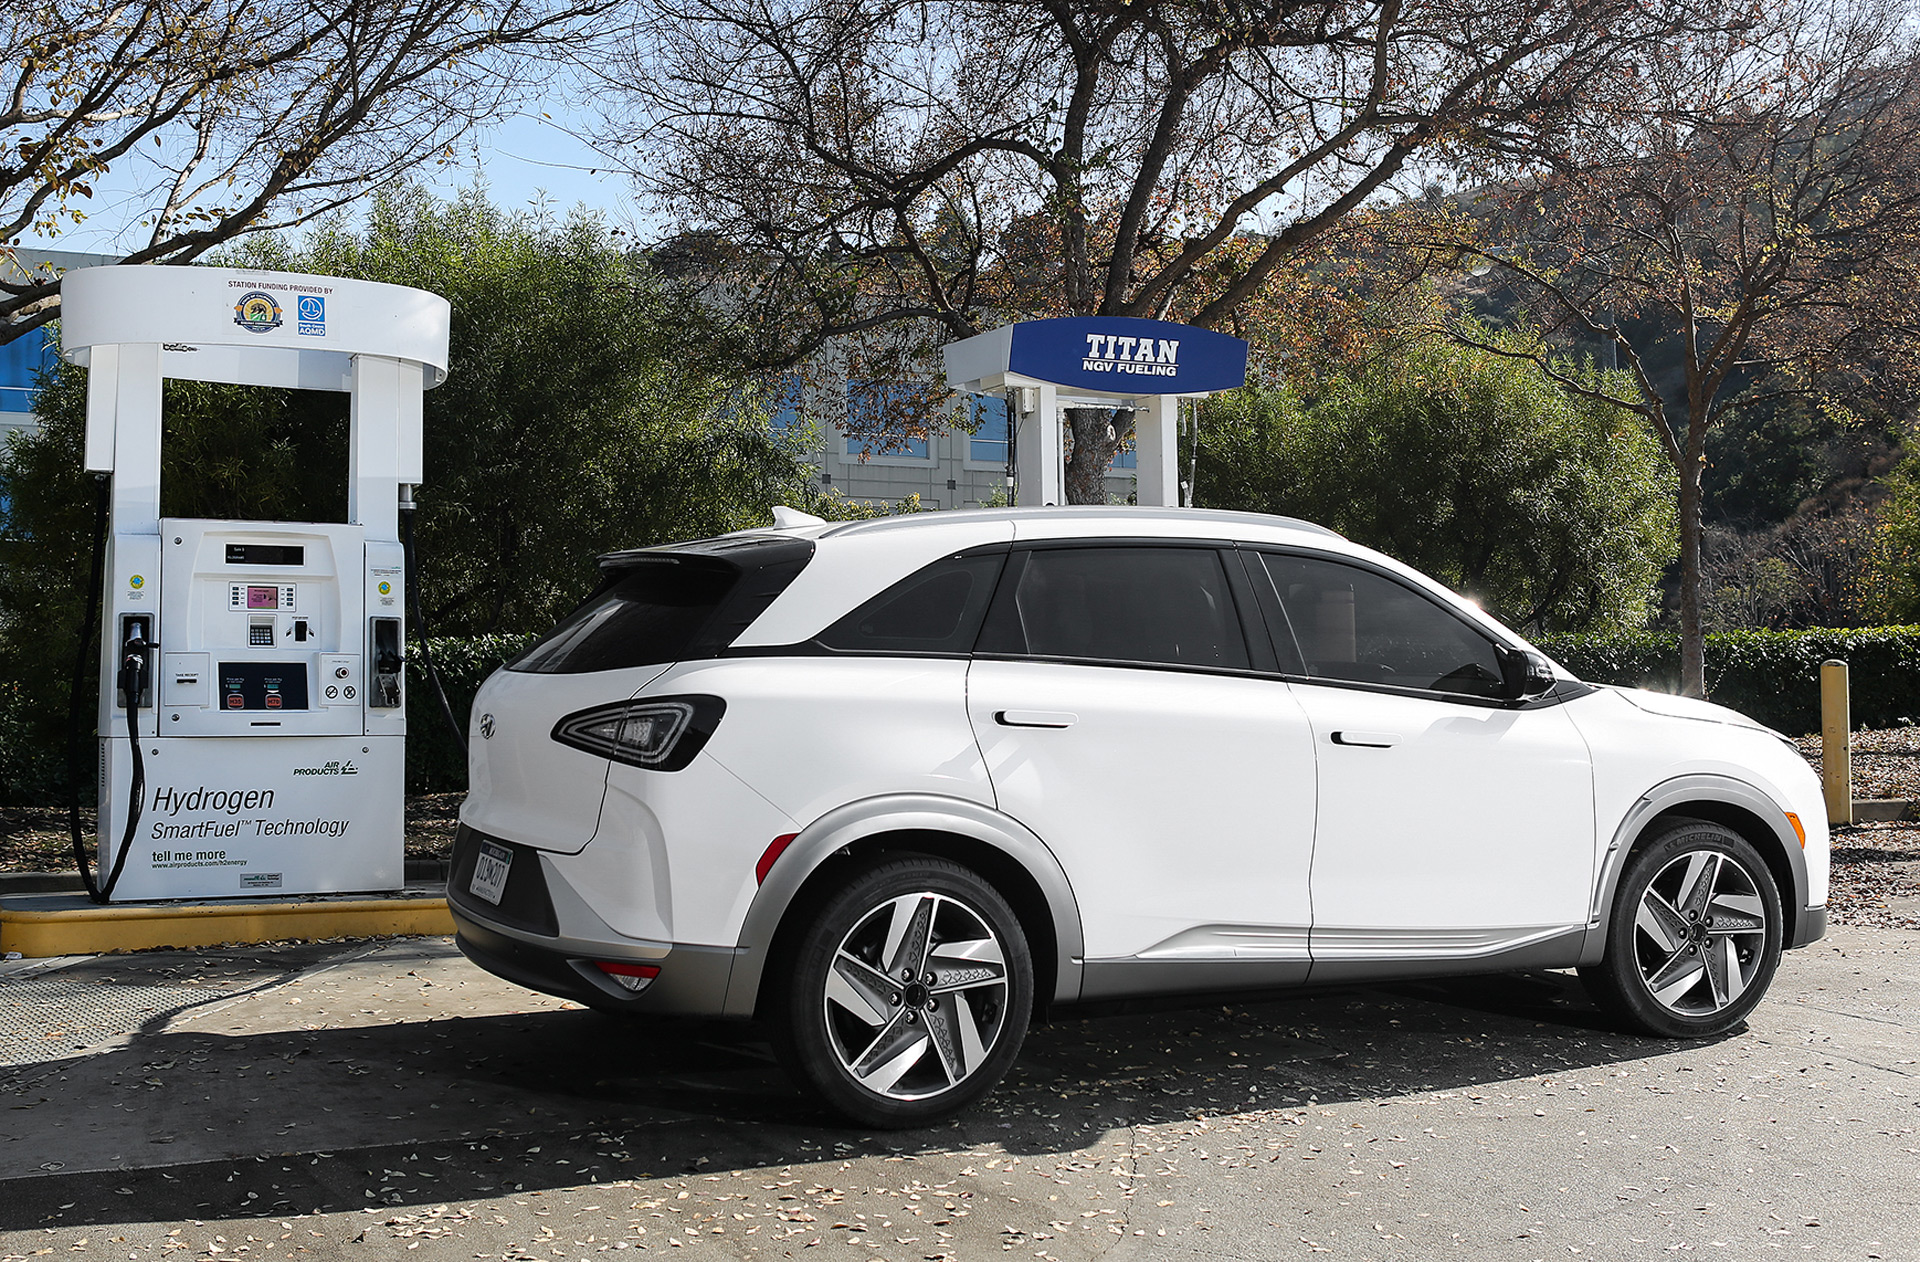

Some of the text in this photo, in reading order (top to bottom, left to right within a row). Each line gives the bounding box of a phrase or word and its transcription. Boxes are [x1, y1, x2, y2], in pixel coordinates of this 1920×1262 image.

[258, 282, 288, 291] FUNDING
[290, 285, 322, 294] PROVIDED
[299, 328, 325, 336] AQMD
[1086, 334, 1180, 364] TITAN
[1082, 360, 1177, 376] NGV FUELING
[152, 786, 274, 816] Hydrogen
[255, 818, 350, 838] Technology
[1676, 832, 1722, 846] MICHELIN
[152, 850, 226, 862] tell me more
[152, 860, 248, 868] www.airproducts.com/h2energy
